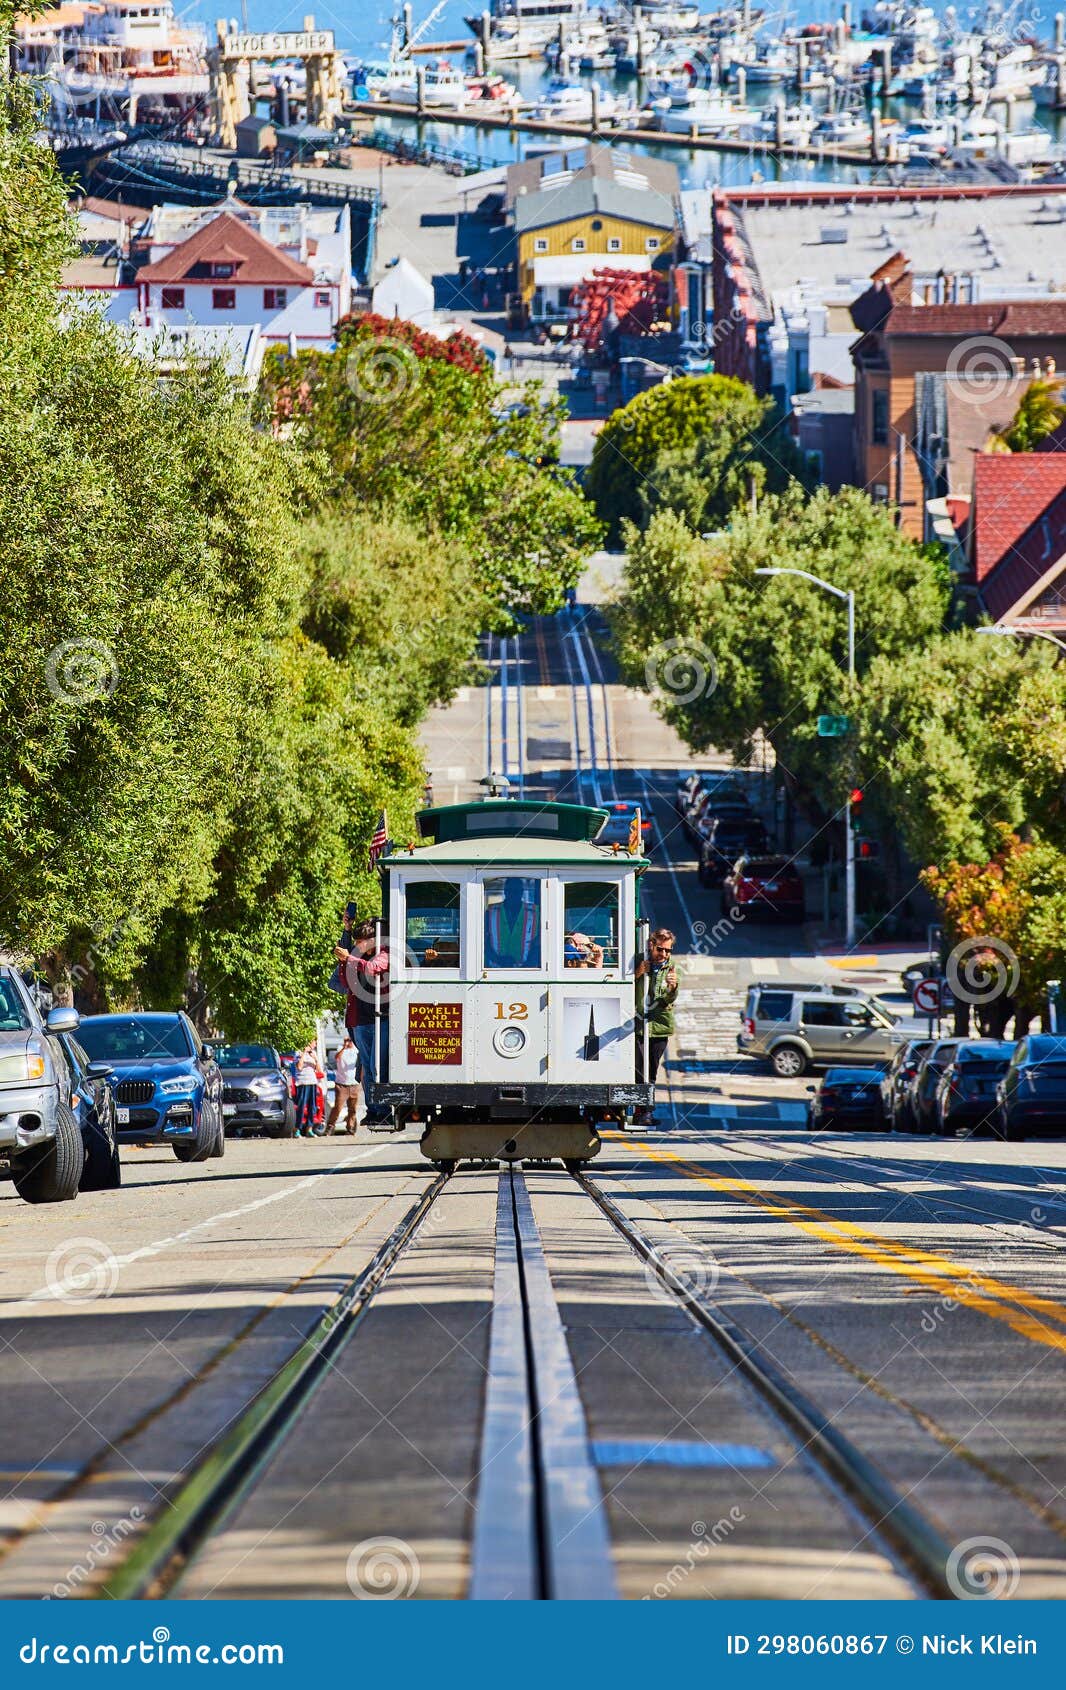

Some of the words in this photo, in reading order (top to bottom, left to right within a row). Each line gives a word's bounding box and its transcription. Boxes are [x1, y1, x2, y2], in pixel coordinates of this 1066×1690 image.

[230, 36, 265, 51] HYDE
[273, 36, 289, 49] ST
[296, 34, 327, 48] PIER
[411, 1006, 460, 1015] POWELL
[494, 1001, 529, 1021] 12
[409, 1020, 460, 1029] MARKET
[410, 1037, 428, 1047] HYDE
[438, 1037, 461, 1047] BEACH
